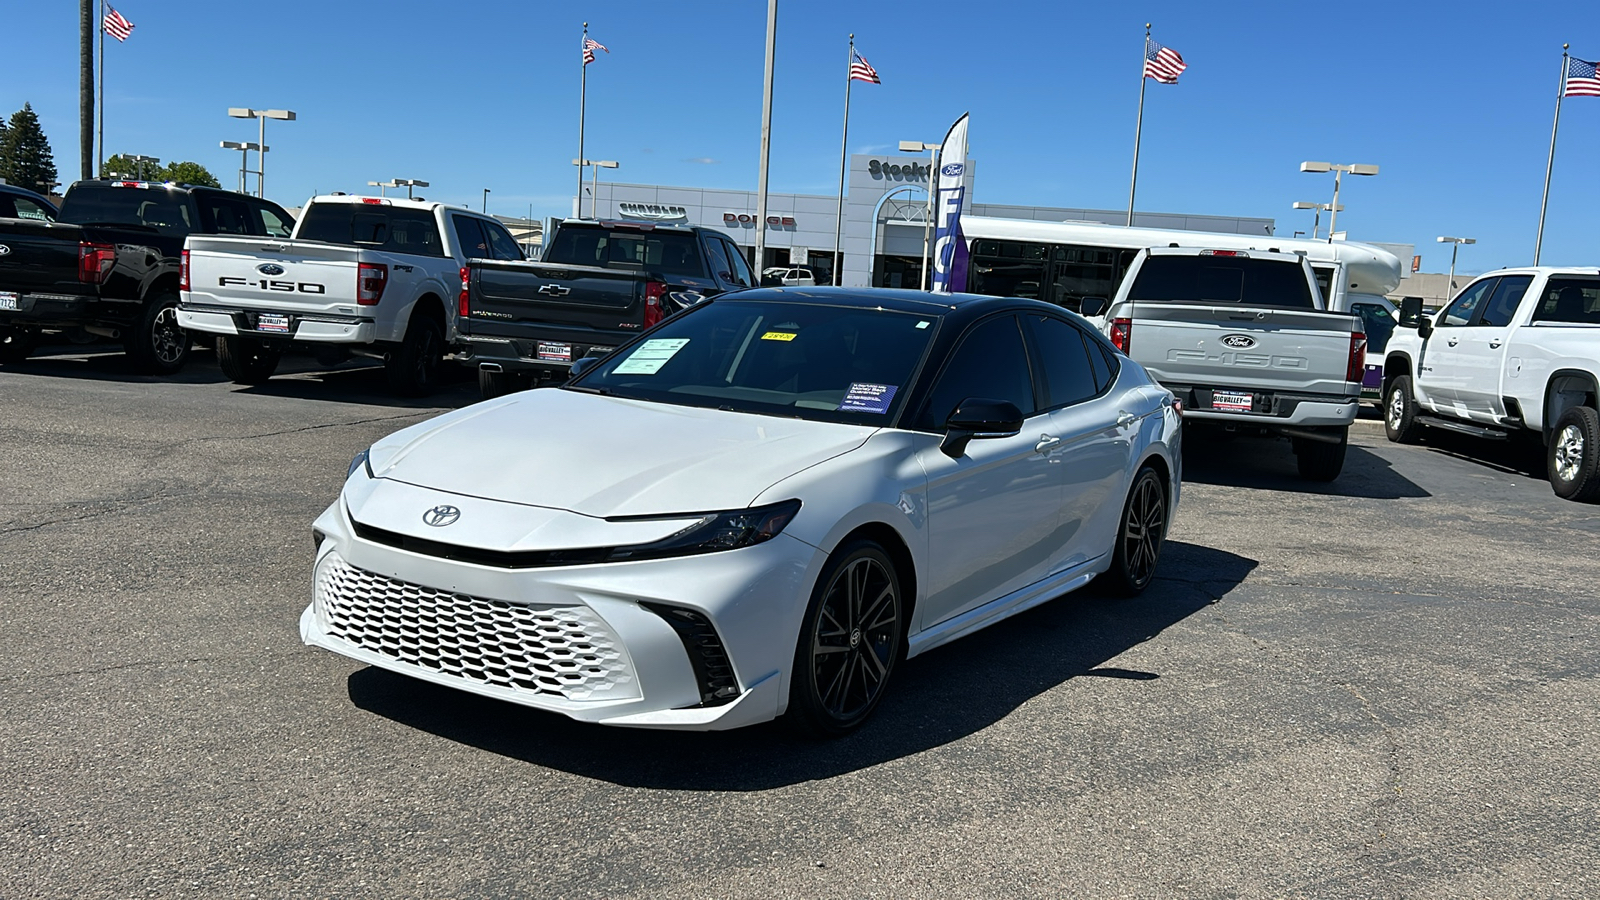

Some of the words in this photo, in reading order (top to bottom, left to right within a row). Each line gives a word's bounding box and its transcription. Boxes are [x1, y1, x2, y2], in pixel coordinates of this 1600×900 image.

[945, 164, 963, 175] Ford
[619, 203, 687, 215] CHRYSLER
[219, 276, 326, 295] F-150
[1227, 335, 1250, 347] Ford
[1167, 348, 1309, 371] F-150
